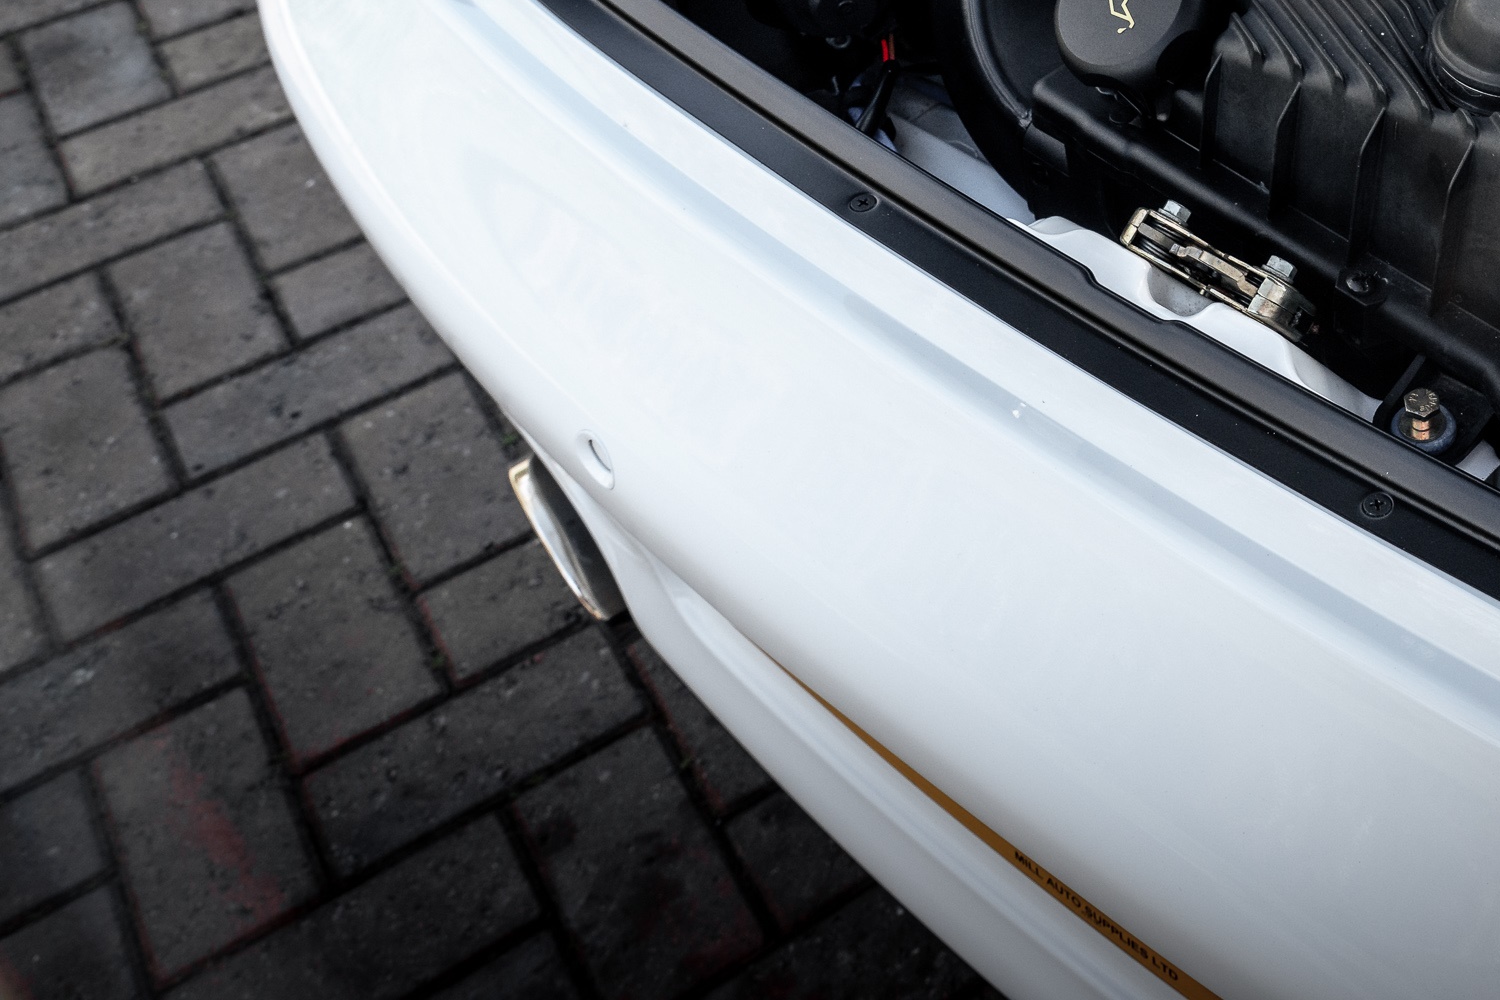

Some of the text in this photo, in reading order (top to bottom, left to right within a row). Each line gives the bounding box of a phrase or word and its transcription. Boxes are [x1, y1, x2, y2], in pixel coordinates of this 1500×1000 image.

[1014, 851, 1179, 981] MILL AUTO SUPPLIES LTD
